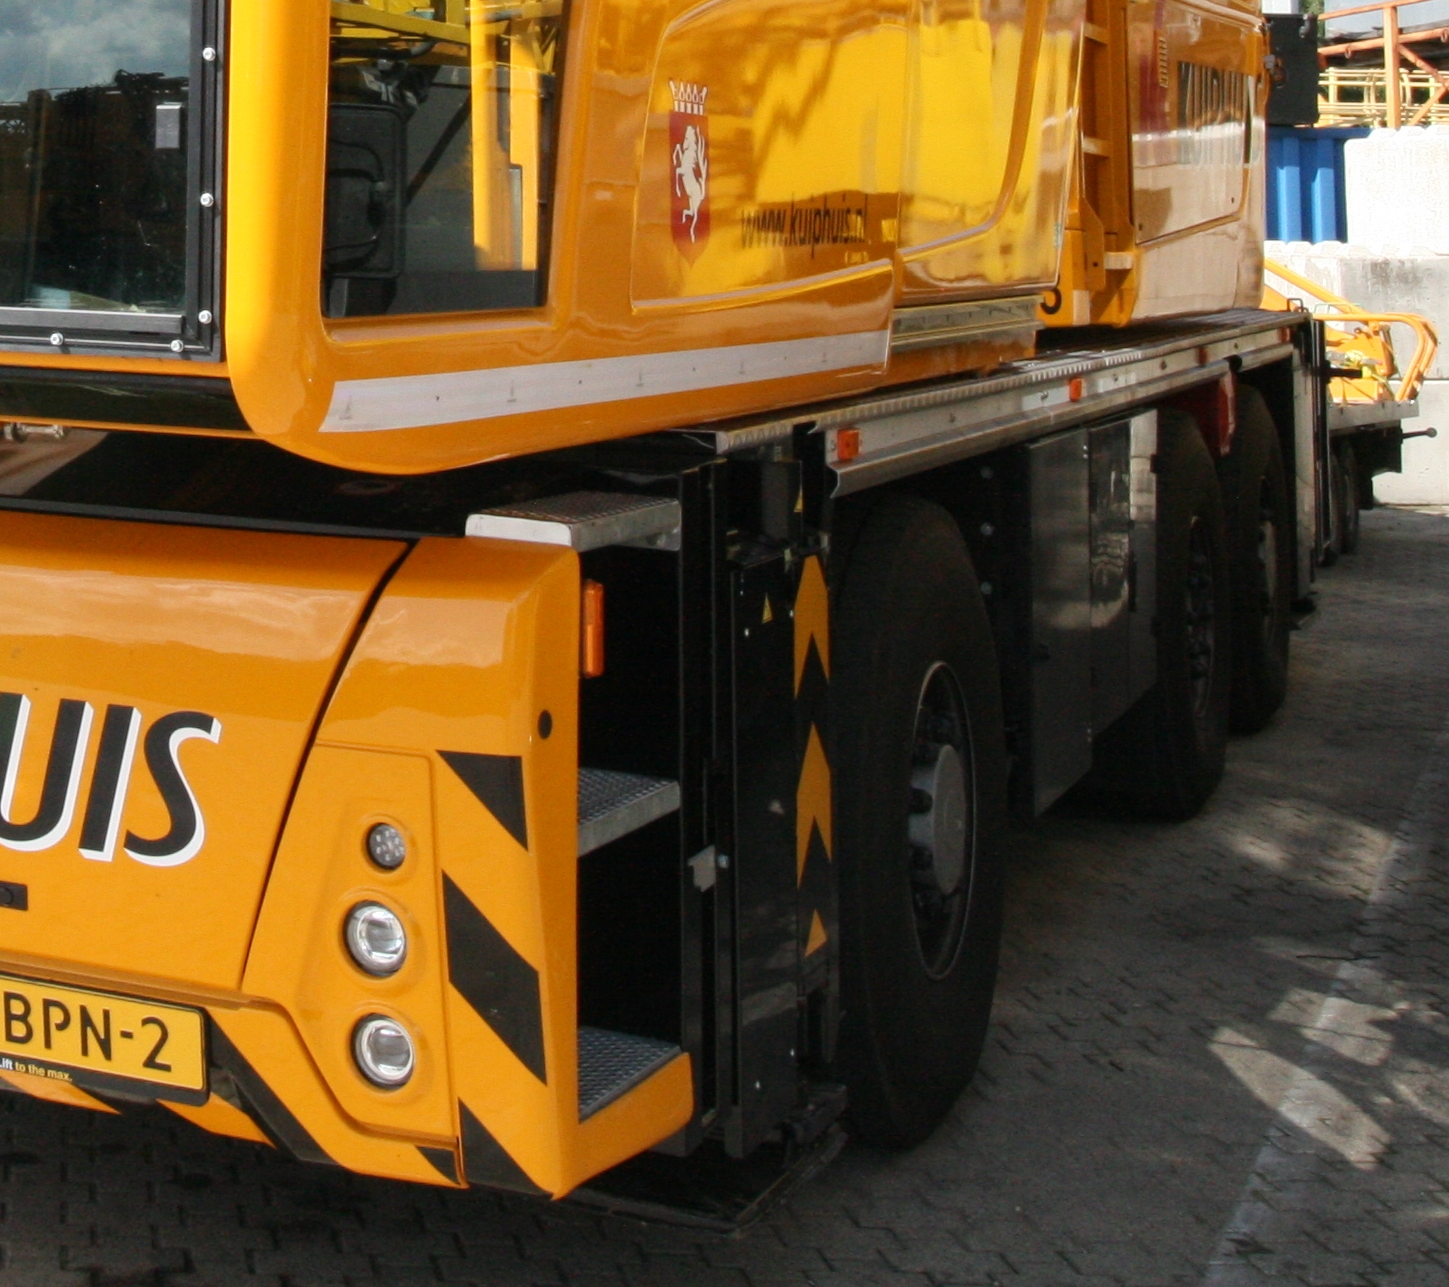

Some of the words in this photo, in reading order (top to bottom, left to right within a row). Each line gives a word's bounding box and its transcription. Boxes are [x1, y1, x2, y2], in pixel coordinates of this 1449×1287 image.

[15, 1061, 26, 1073] to
[28, 1064, 46, 1077] the
[47, 1068, 73, 1082] max.
